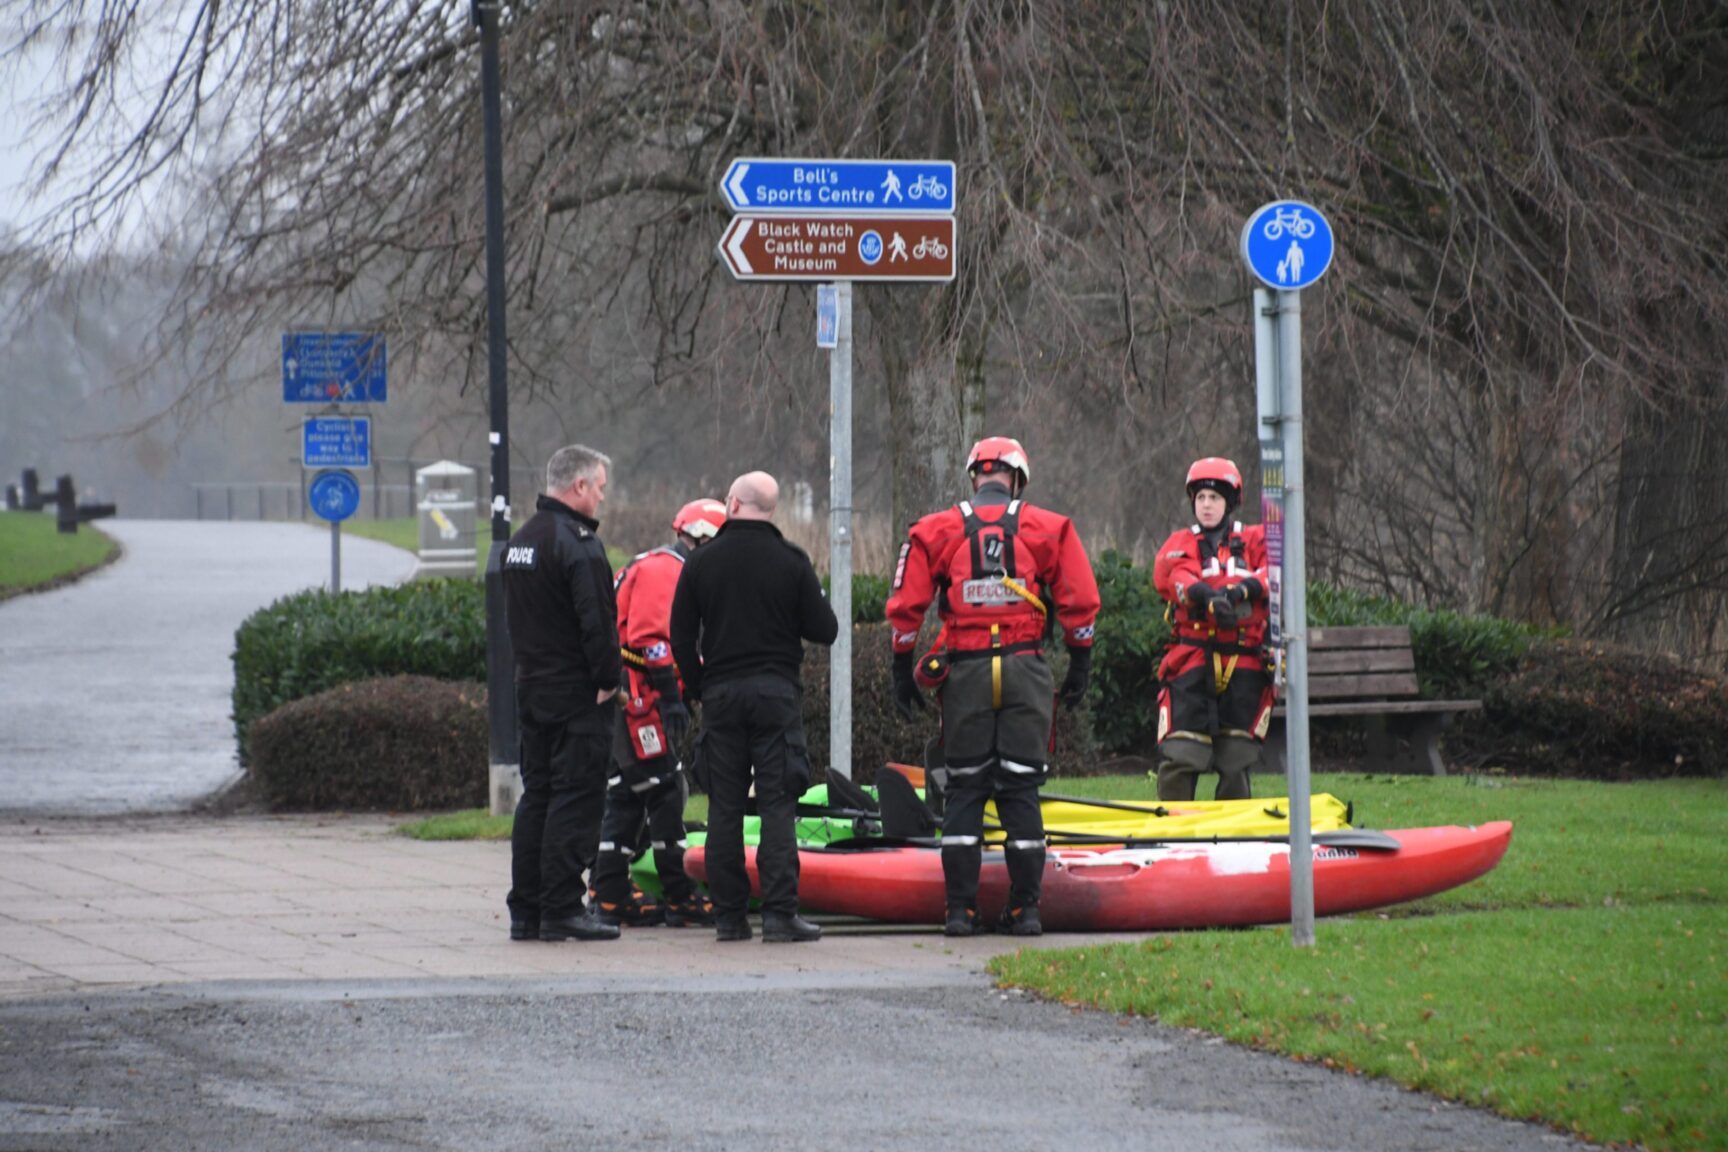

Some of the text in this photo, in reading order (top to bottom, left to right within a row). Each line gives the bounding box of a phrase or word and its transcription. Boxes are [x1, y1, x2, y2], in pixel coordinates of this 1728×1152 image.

[793, 167, 839, 184] Bell's
[756, 185, 875, 204] Sports Centre
[758, 221, 854, 237] Black Watch
[764, 238, 846, 254] Castle and
[774, 255, 837, 270] Museum
[506, 546, 535, 565] POLICE
[966, 583, 1019, 599] RESCU
